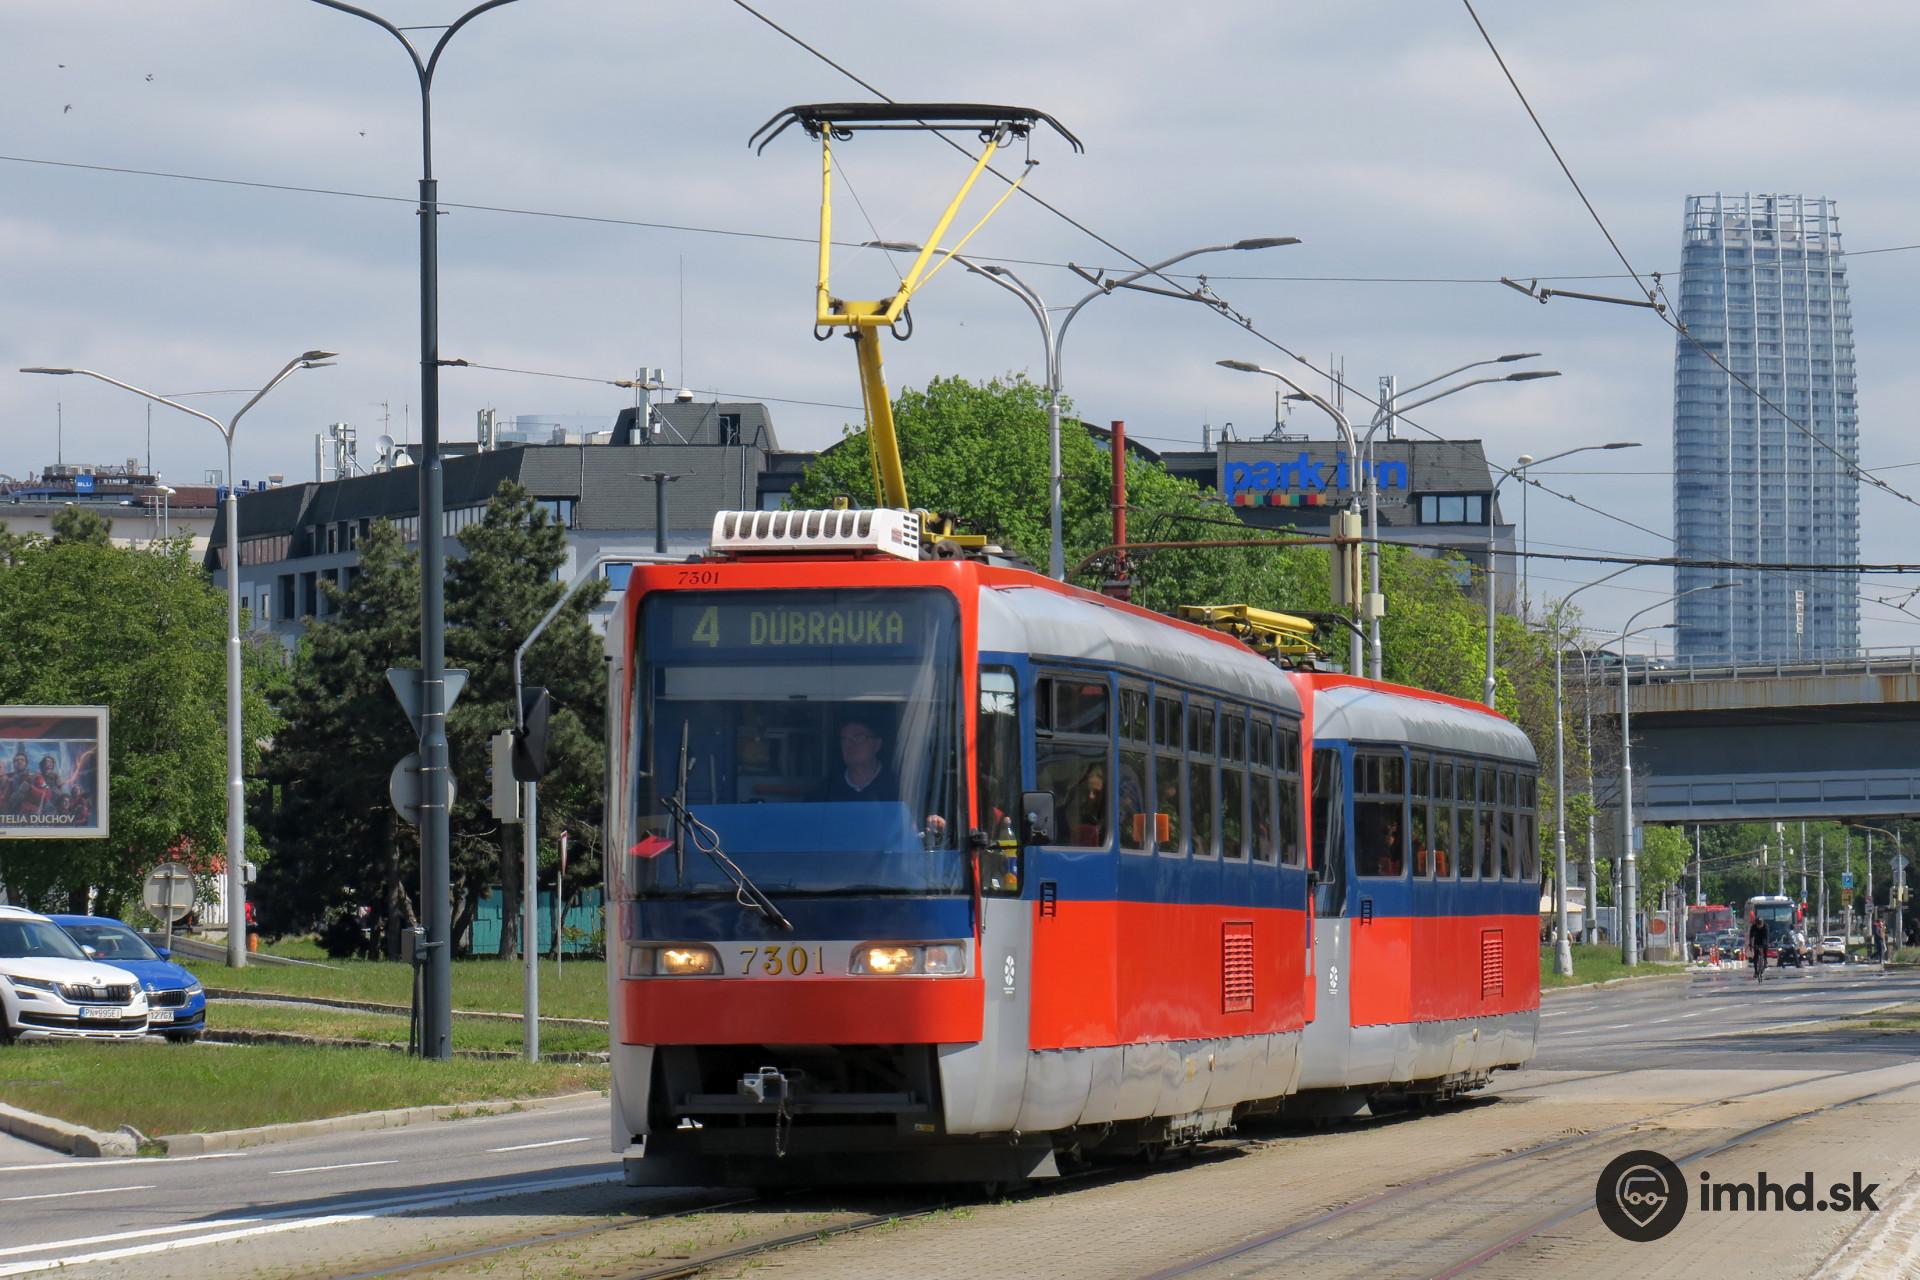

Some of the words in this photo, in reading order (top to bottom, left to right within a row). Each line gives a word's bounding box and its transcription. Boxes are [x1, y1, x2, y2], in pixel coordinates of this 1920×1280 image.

[1223, 451, 1327, 506] park
[677, 571, 720, 585] 7301
[692, 606, 720, 647] 4
[30, 814, 76, 824] DUCHOV
[739, 944, 825, 976] 7301
